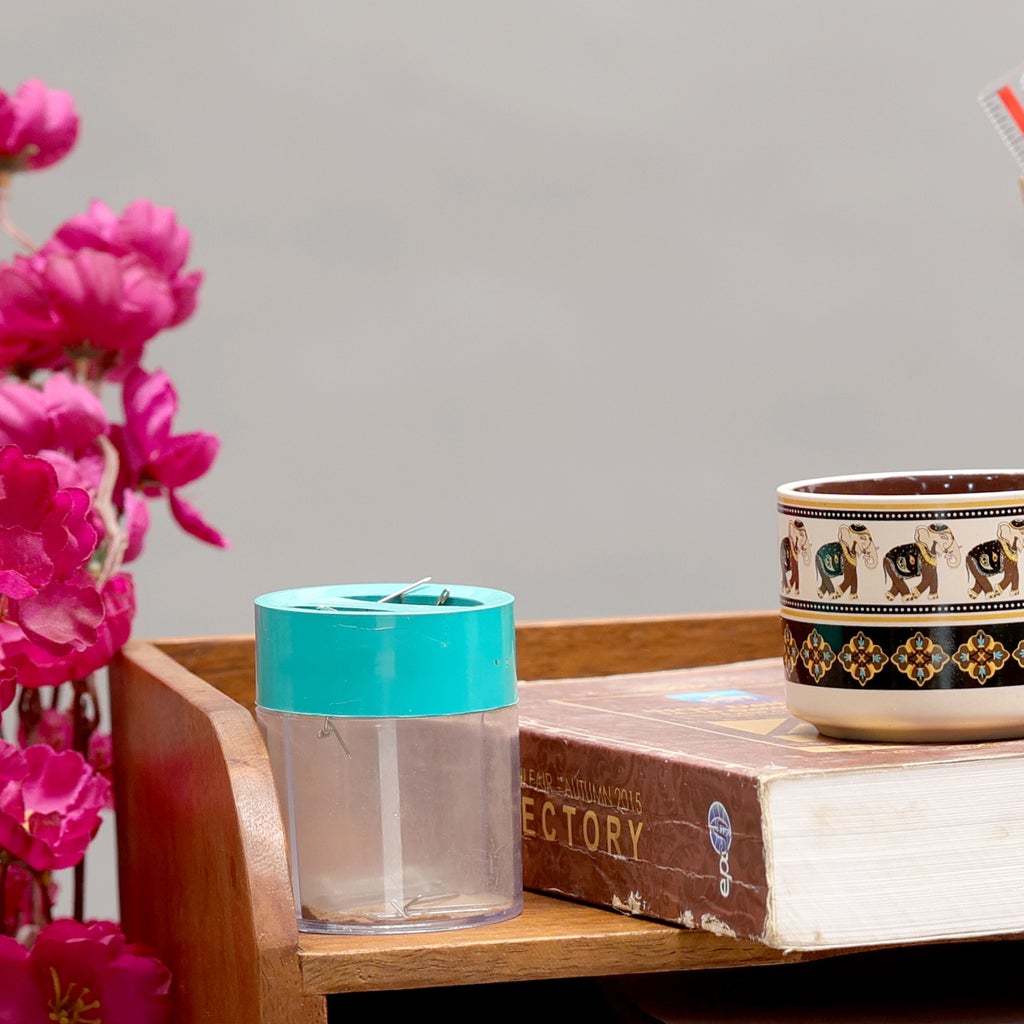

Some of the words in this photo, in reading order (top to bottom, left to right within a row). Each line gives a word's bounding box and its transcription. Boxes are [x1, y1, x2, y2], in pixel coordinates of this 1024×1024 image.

[564, 777, 613, 808] AUTUMN
[614, 787, 643, 815] 2015
[521, 796, 644, 861] ECTORY
